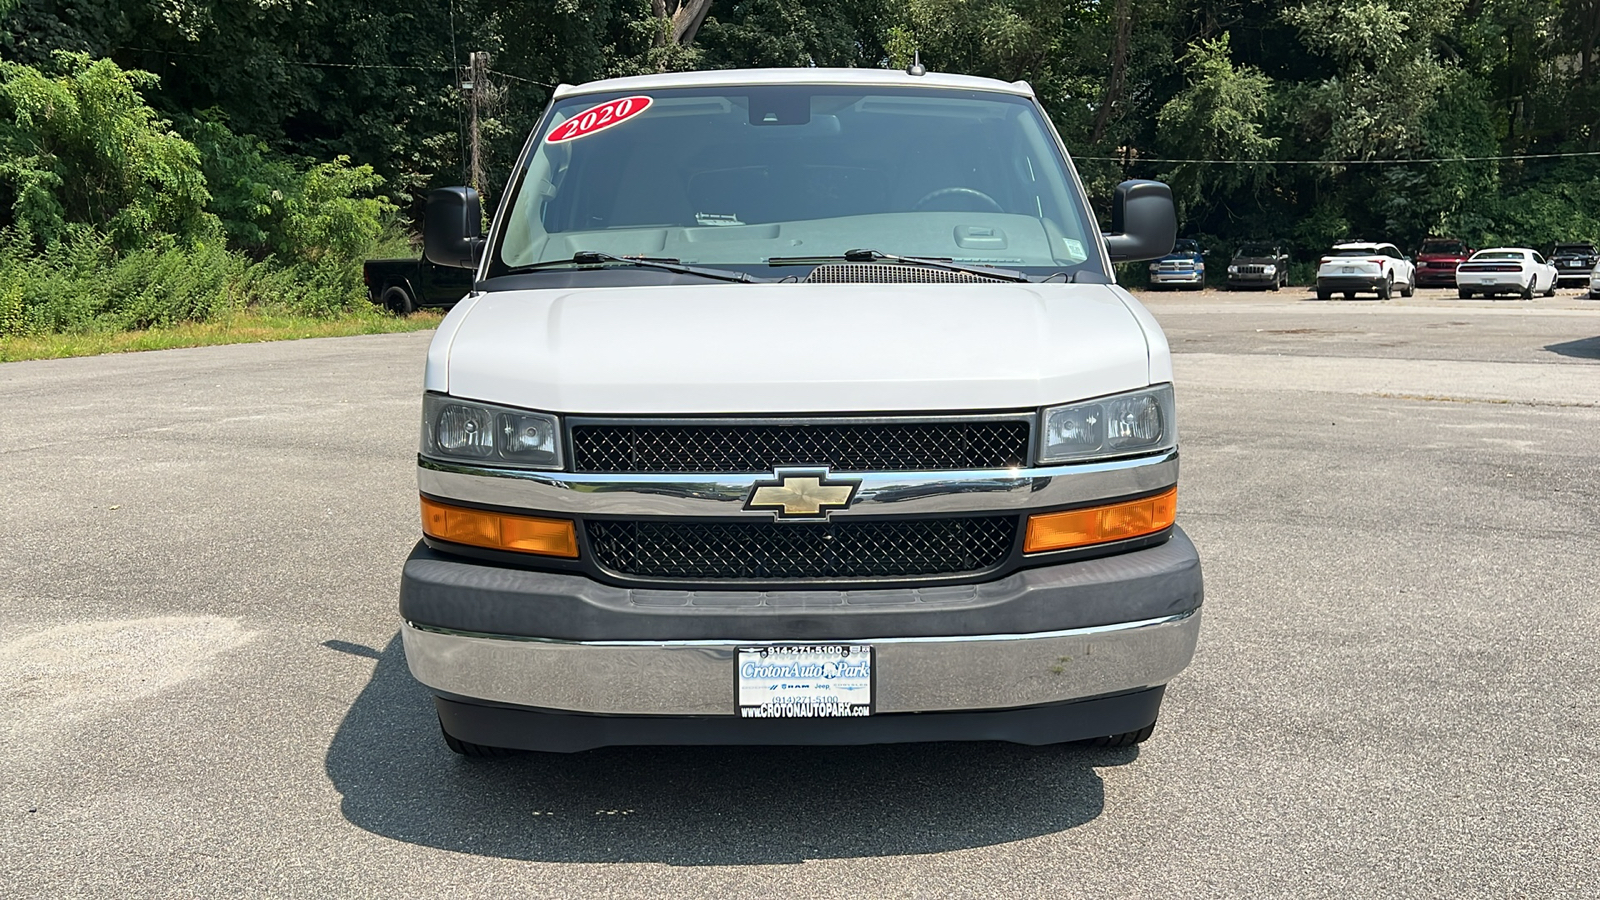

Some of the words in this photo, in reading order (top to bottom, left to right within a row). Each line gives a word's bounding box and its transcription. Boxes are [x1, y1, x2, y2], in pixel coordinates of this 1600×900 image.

[562, 99, 632, 139] 2020
[836, 660, 869, 678] Park
[772, 696, 838, 704] (914)271-5100
